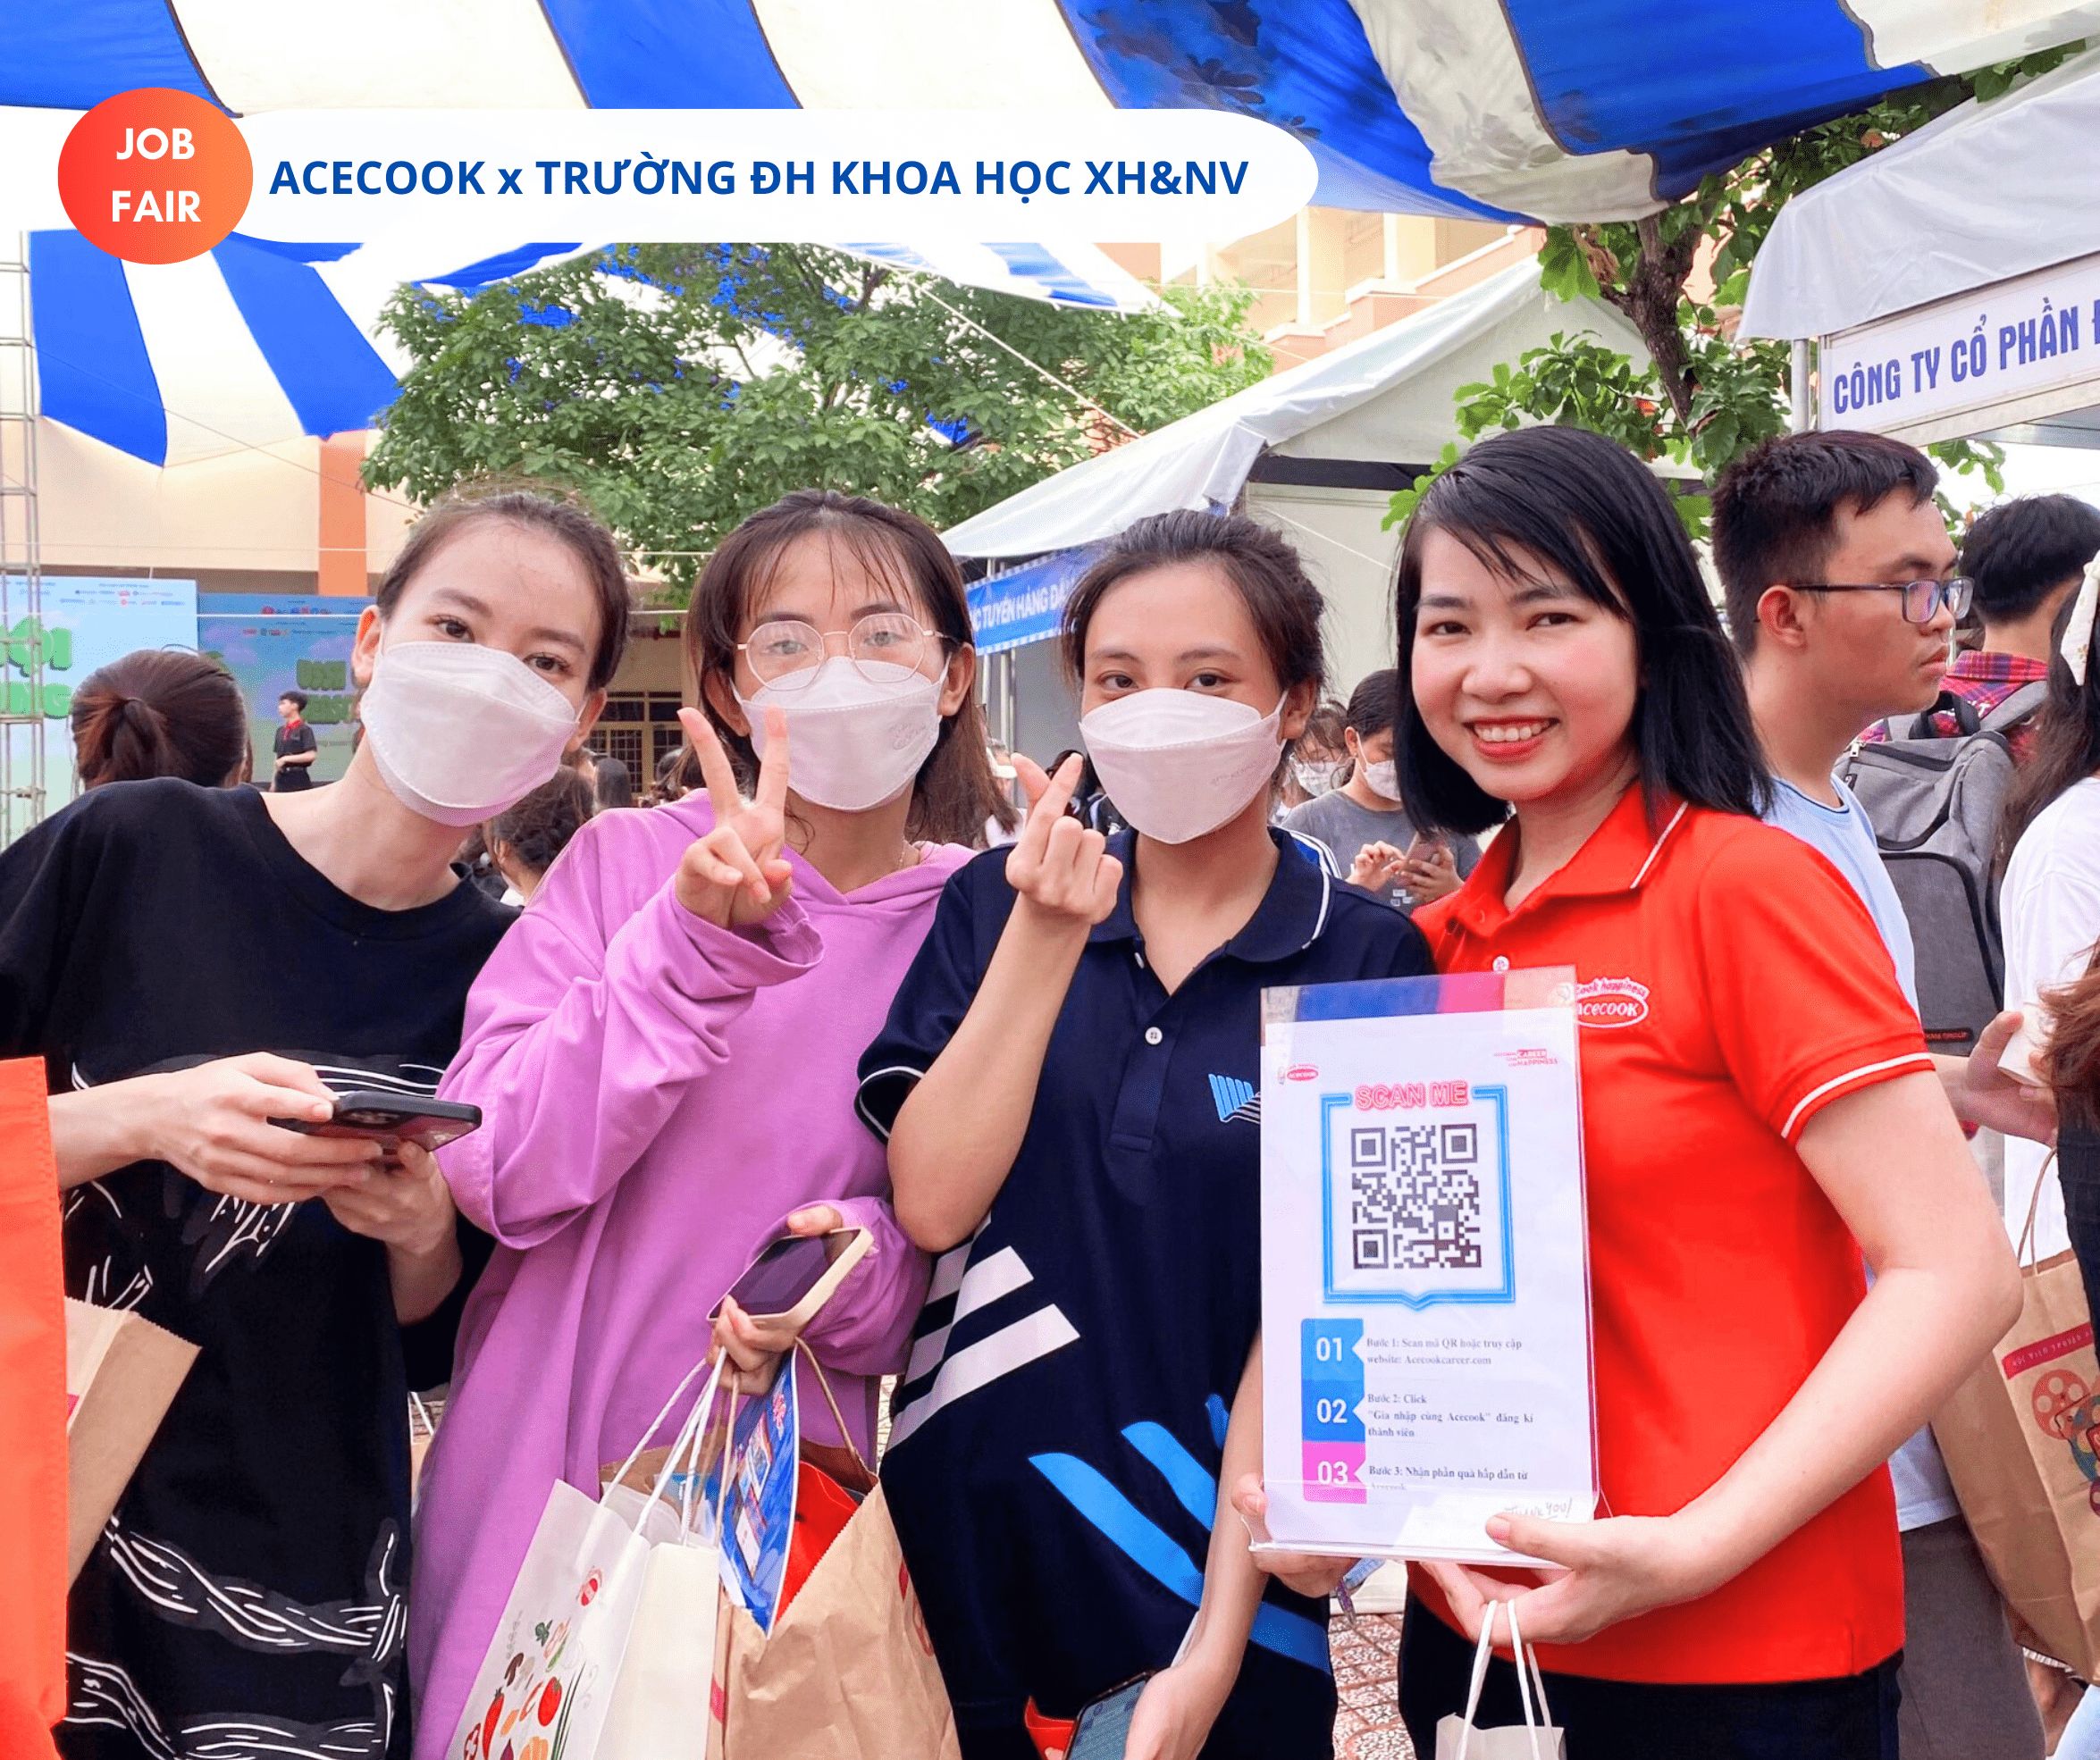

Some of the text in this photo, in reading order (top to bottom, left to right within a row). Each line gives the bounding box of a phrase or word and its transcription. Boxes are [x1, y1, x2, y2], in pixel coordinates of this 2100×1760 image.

[1834, 359, 1901, 415] CÔNG
[1911, 347, 1940, 393] TY
[1951, 314, 1987, 382] CỔ
[1999, 297, 2079, 370] PHẦN
[1356, 1079, 1468, 1110] SCAN ME
[1316, 1337, 1343, 1362] 01
[1402, 1338, 1424, 1348] Scan
[1441, 1338, 1457, 1350] QR
[1483, 1339, 1502, 1351] truy
[1316, 1398, 1348, 1424] 02
[1403, 1394, 1428, 1404] Click
[1317, 1461, 1349, 1486] 03
